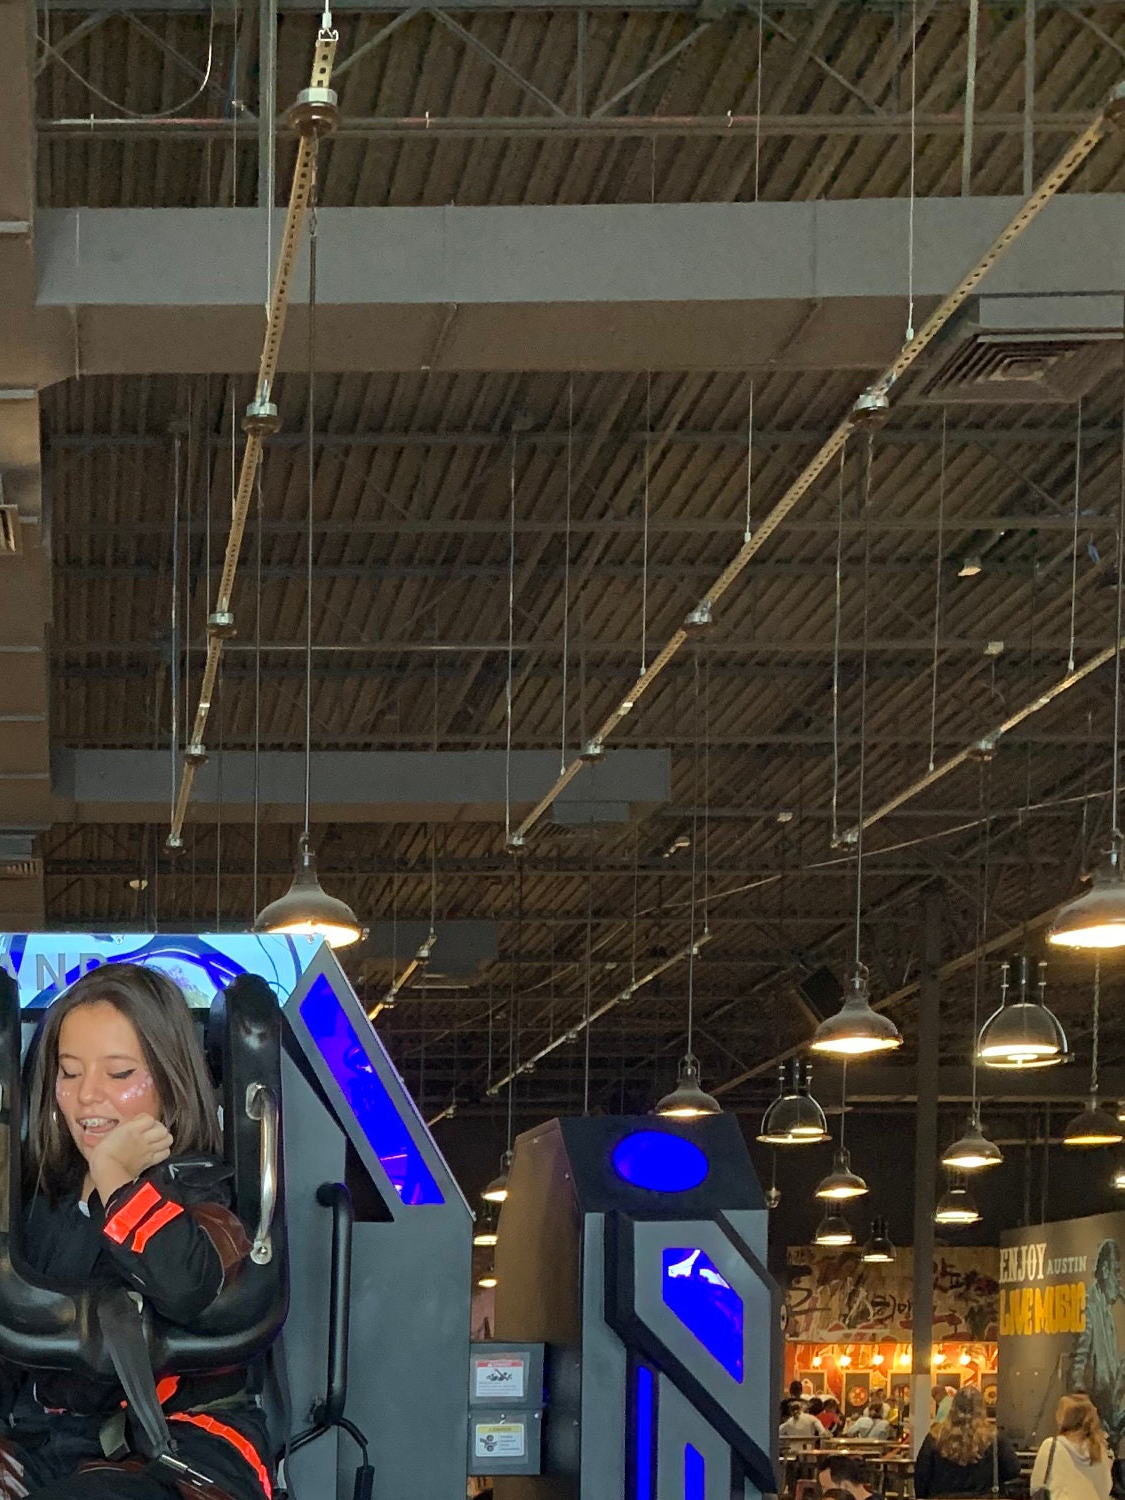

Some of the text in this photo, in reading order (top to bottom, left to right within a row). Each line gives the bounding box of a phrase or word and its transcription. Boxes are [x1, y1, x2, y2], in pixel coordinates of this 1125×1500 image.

[999, 1243, 1047, 1284] ENJOY
[1046, 1256, 1087, 1275] AUSTIN
[999, 1281, 1086, 1336] LIVE MUSIC
